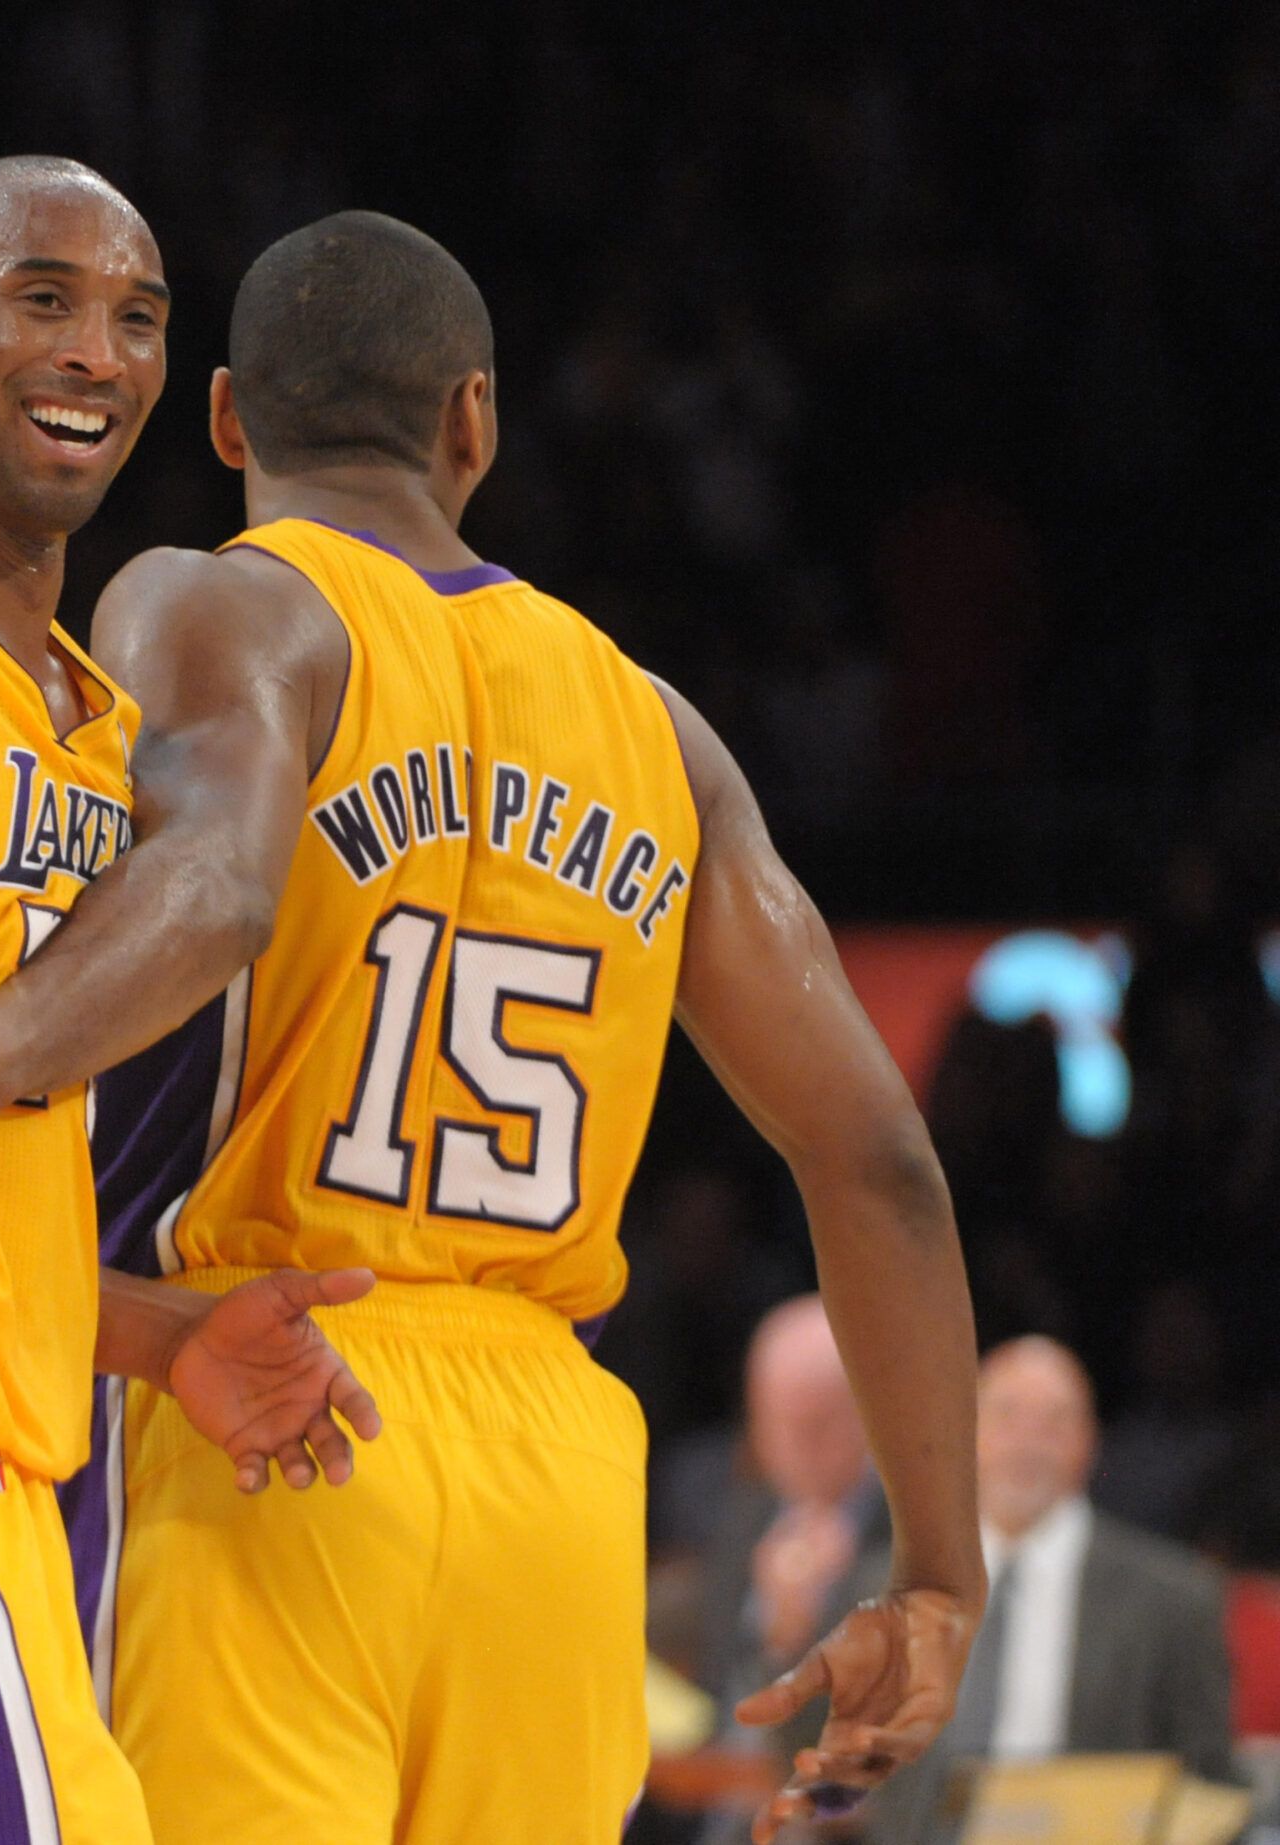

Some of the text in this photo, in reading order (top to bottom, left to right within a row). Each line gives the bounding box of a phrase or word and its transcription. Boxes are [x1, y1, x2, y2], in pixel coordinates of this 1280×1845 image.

[308, 742, 690, 949] WORL PEACE
[315, 901, 603, 1234] 15
